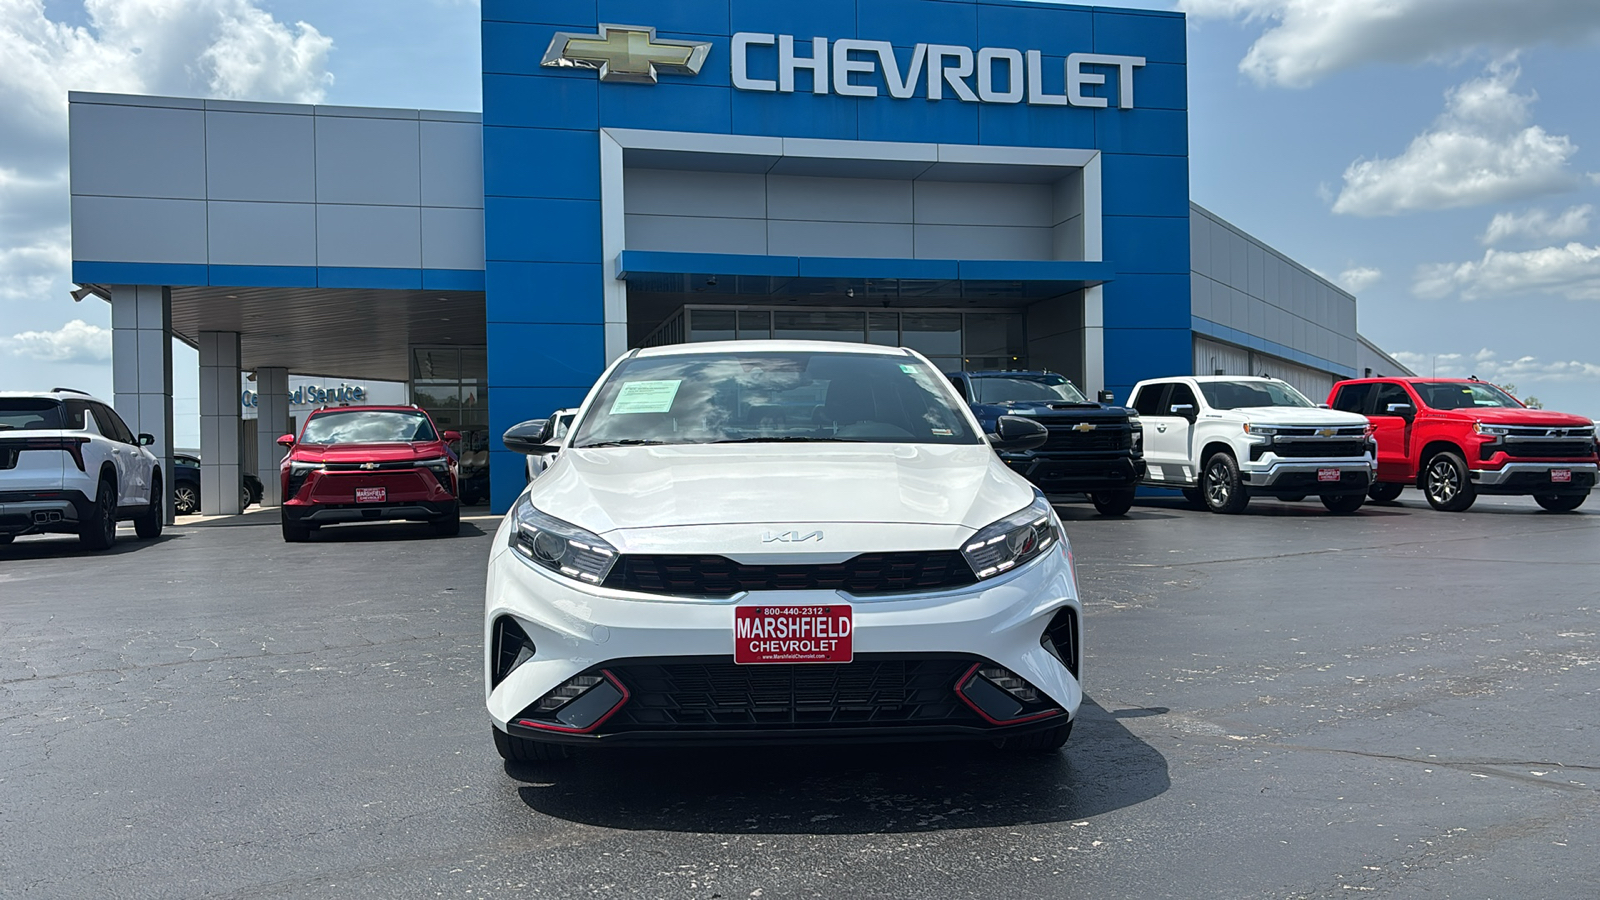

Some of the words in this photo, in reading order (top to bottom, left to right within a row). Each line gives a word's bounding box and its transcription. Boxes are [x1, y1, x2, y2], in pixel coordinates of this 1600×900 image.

[731, 32, 1147, 110] CHEVROLET
[307, 383, 363, 403] Service
[764, 607, 823, 616] 800-440-2312
[737, 616, 851, 639] MARSHFIELD
[749, 640, 838, 653] CHEVROLET
